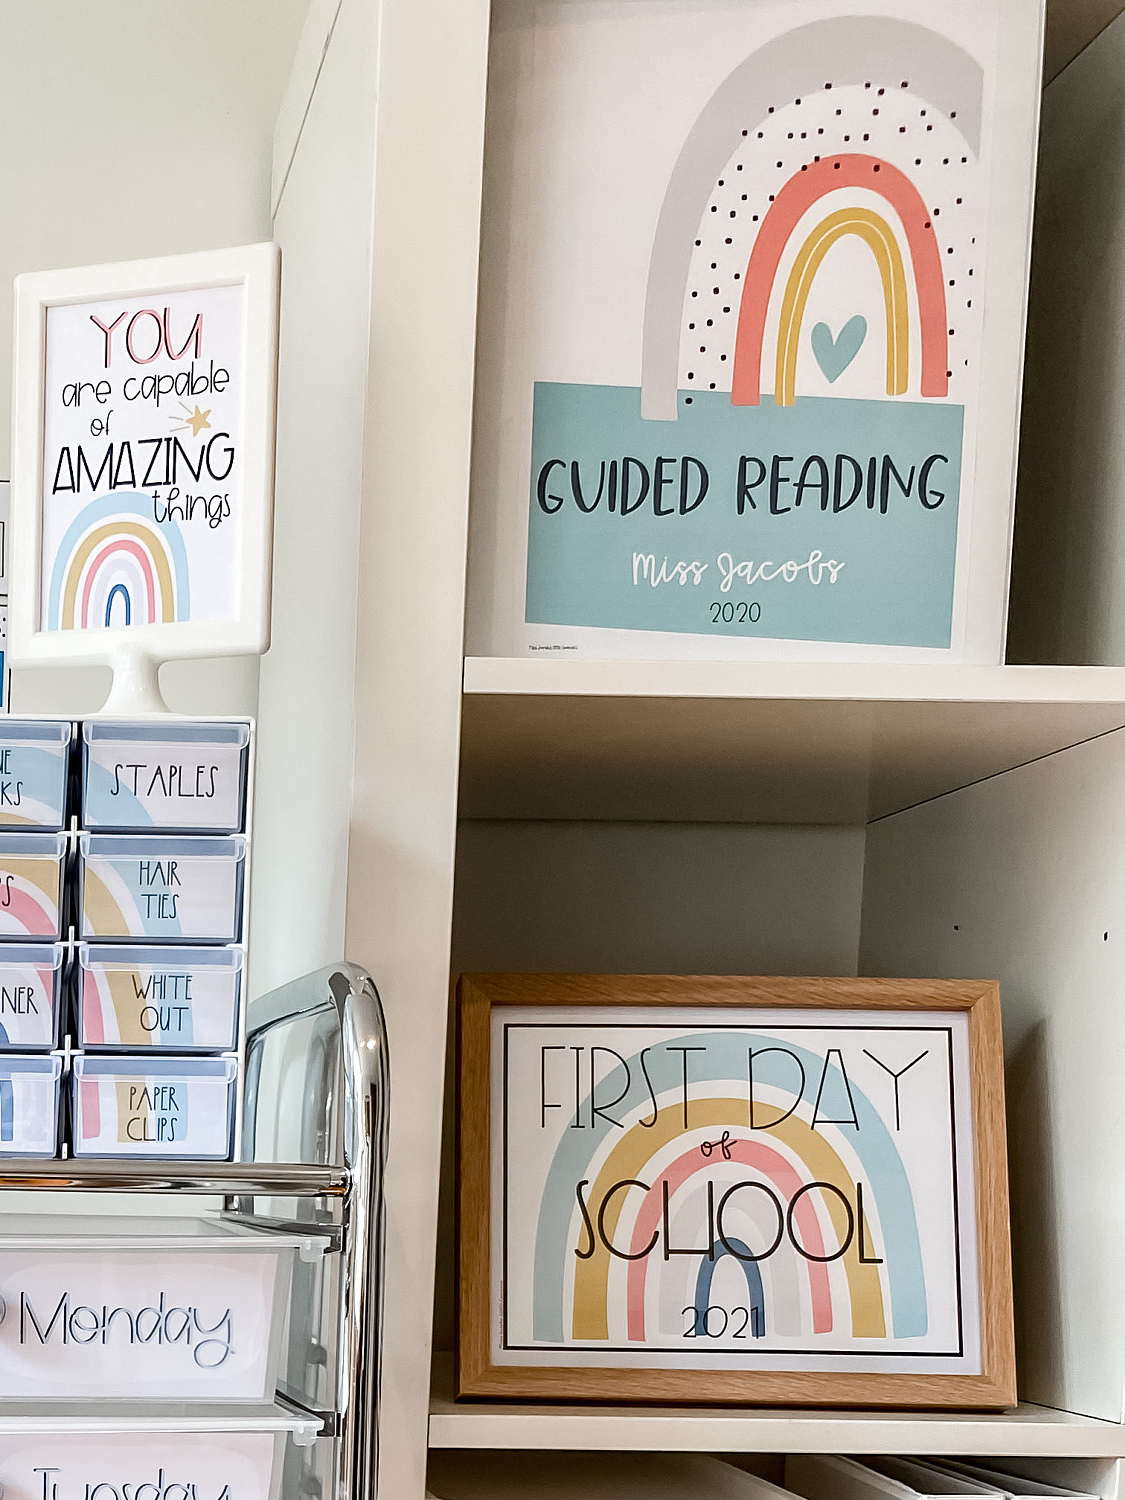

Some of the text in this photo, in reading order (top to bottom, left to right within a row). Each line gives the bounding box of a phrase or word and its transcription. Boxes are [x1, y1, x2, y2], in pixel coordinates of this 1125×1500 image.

[89, 306, 204, 369] YOU
[62, 361, 230, 408] are capable
[90, 409, 114, 437] of
[52, 432, 236, 496] AMAZING
[537, 453, 949, 517] GUIDED READING
[151, 488, 231, 529] things
[631, 549, 846, 593] Miss Jacobs
[709, 602, 761, 623] 2020
[110, 763, 219, 798] STAPLES
[139, 860, 182, 886] HAIR
[140, 893, 180, 919] TIES
[131, 974, 193, 1000] WHITE
[140, 1006, 190, 1032] OUT
[129, 1086, 180, 1112] PAPER
[541, 1045, 929, 1131] FIRST DAY
[126, 1117, 178, 1142] CLIPS
[700, 1130, 738, 1160] of
[574, 1179, 884, 1264] SCHOOL
[19, 1291, 237, 1369] Monday
[680, 1305, 762, 1340] 2021
